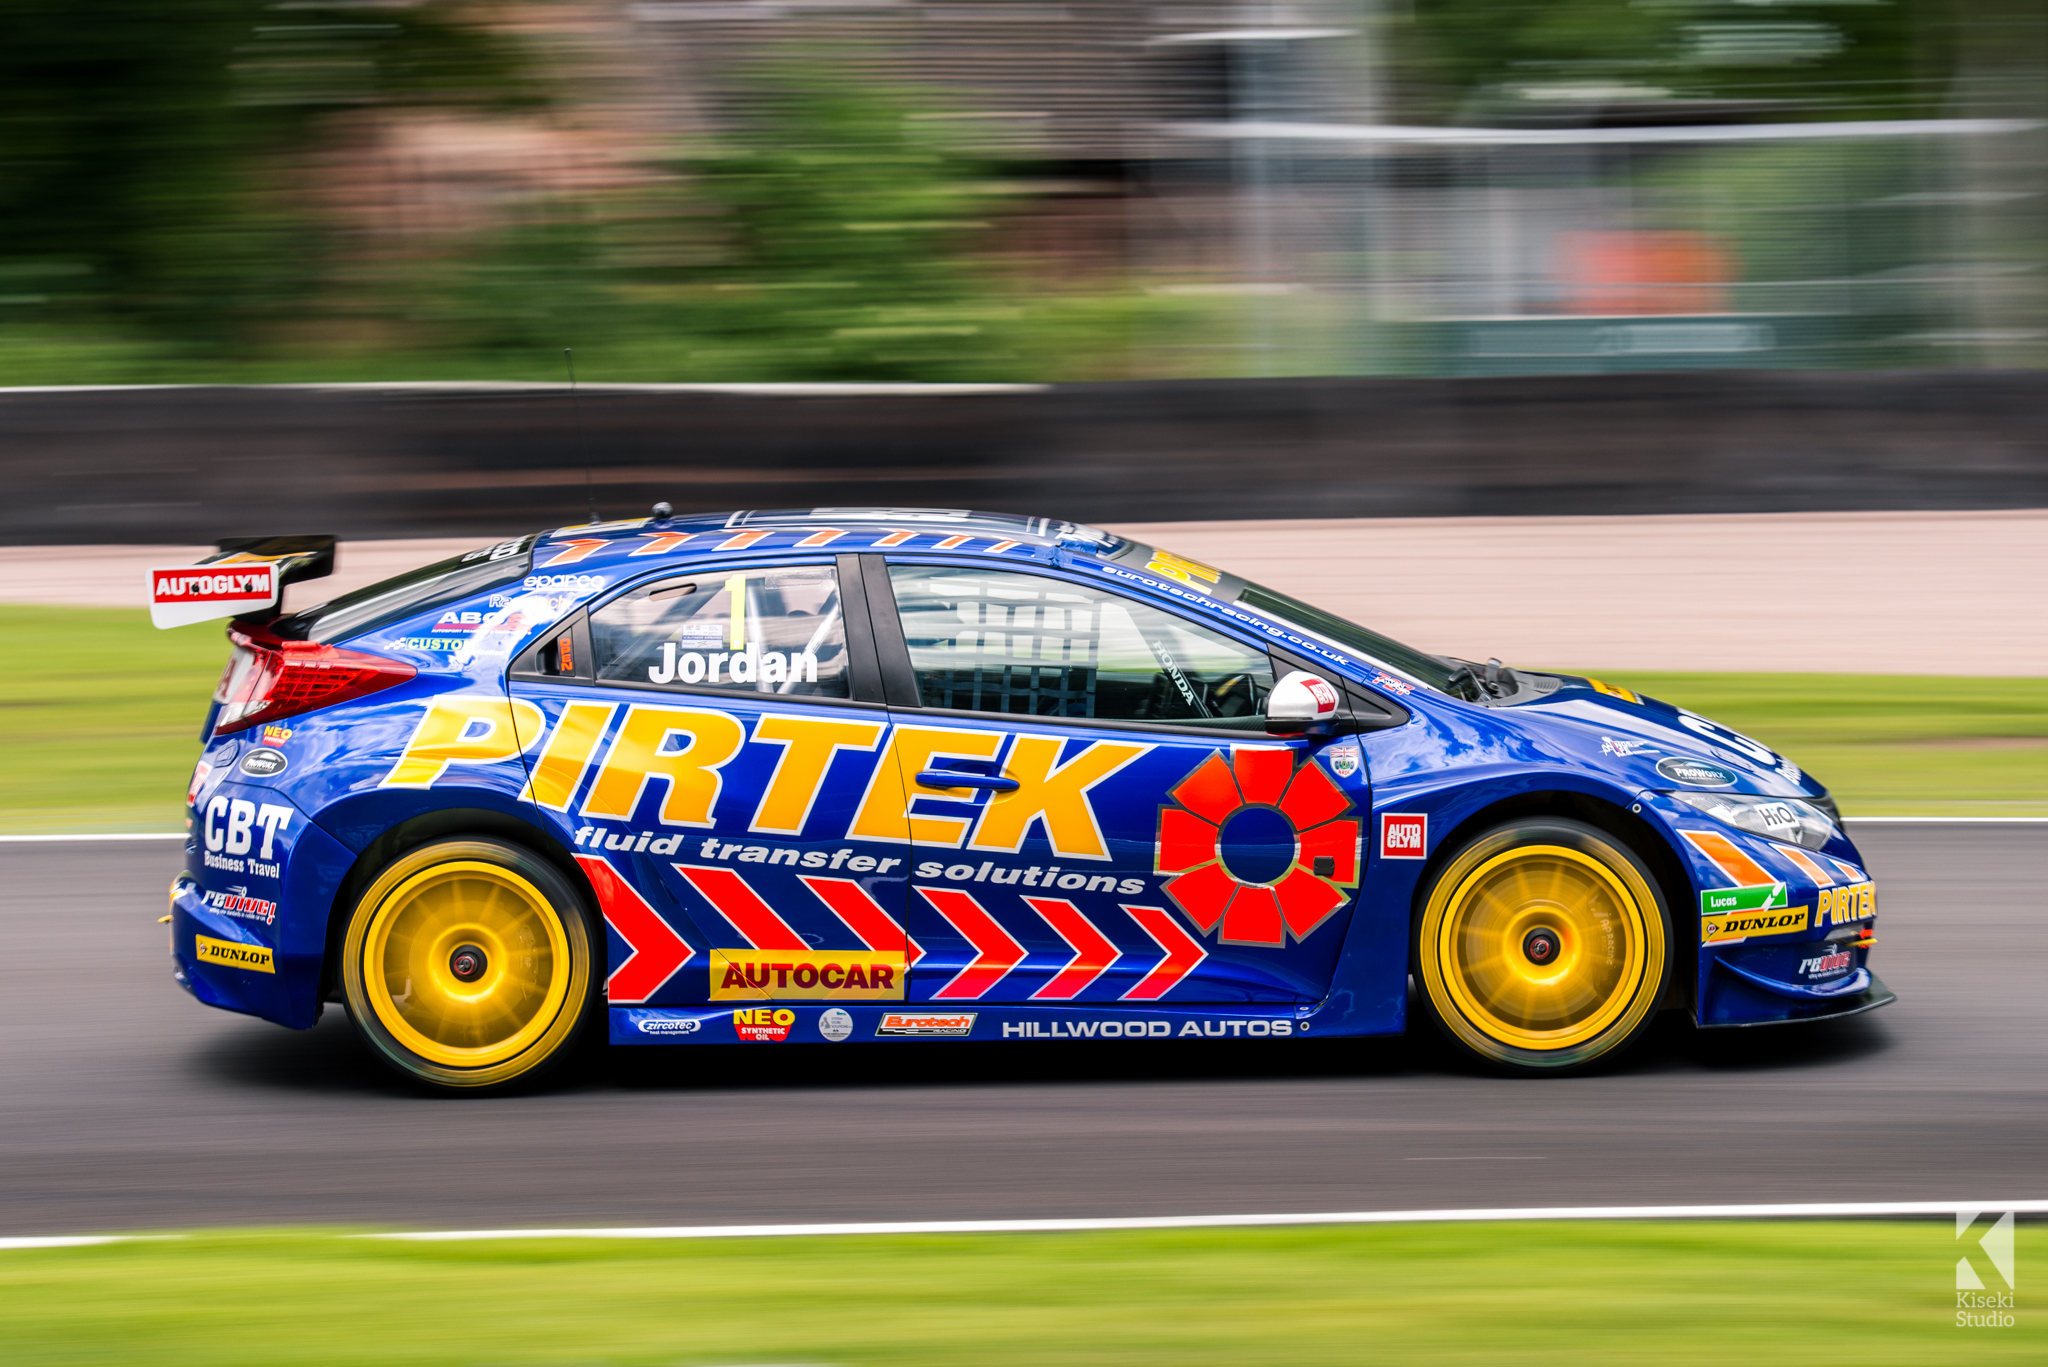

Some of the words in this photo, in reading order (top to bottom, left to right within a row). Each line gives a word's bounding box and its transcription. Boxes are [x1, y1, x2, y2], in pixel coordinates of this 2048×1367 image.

[156, 574, 269, 597] AUTOGLYM
[523, 574, 605, 592] sparco
[1102, 565, 1349, 667] eurotechracing.co.uk
[559, 637, 573, 672] OPEN
[648, 642, 818, 684] Jordan
[1153, 640, 1194, 706] HONDA
[264, 725, 293, 740] NEO
[377, 695, 1158, 862] PIRTEK
[1758, 806, 1796, 826] HiQ
[204, 795, 295, 860] CBT
[1387, 823, 1421, 837] AUTO
[1386, 835, 1421, 849] GLYM
[204, 850, 245, 873] Business
[247, 858, 280, 879] Travel
[574, 826, 683, 856] fluid
[700, 838, 901, 875] transfer
[915, 859, 1146, 895] solutions
[1710, 895, 1737, 908] Lucas
[1723, 913, 1805, 933] DUNLOP
[210, 945, 270, 965] DUNLOP
[720, 963, 895, 990] AUTOCAR
[646, 1021, 693, 1030] zircotec
[733, 1009, 796, 1027] NEO
[884, 1016, 970, 1027] Eurotech
[741, 1027, 785, 1035] SYNTHETIC
[755, 1033, 770, 1041] OIL
[1002, 1021, 1172, 1038] HILLWOOD
[1178, 1020, 1293, 1037] AUTOS
